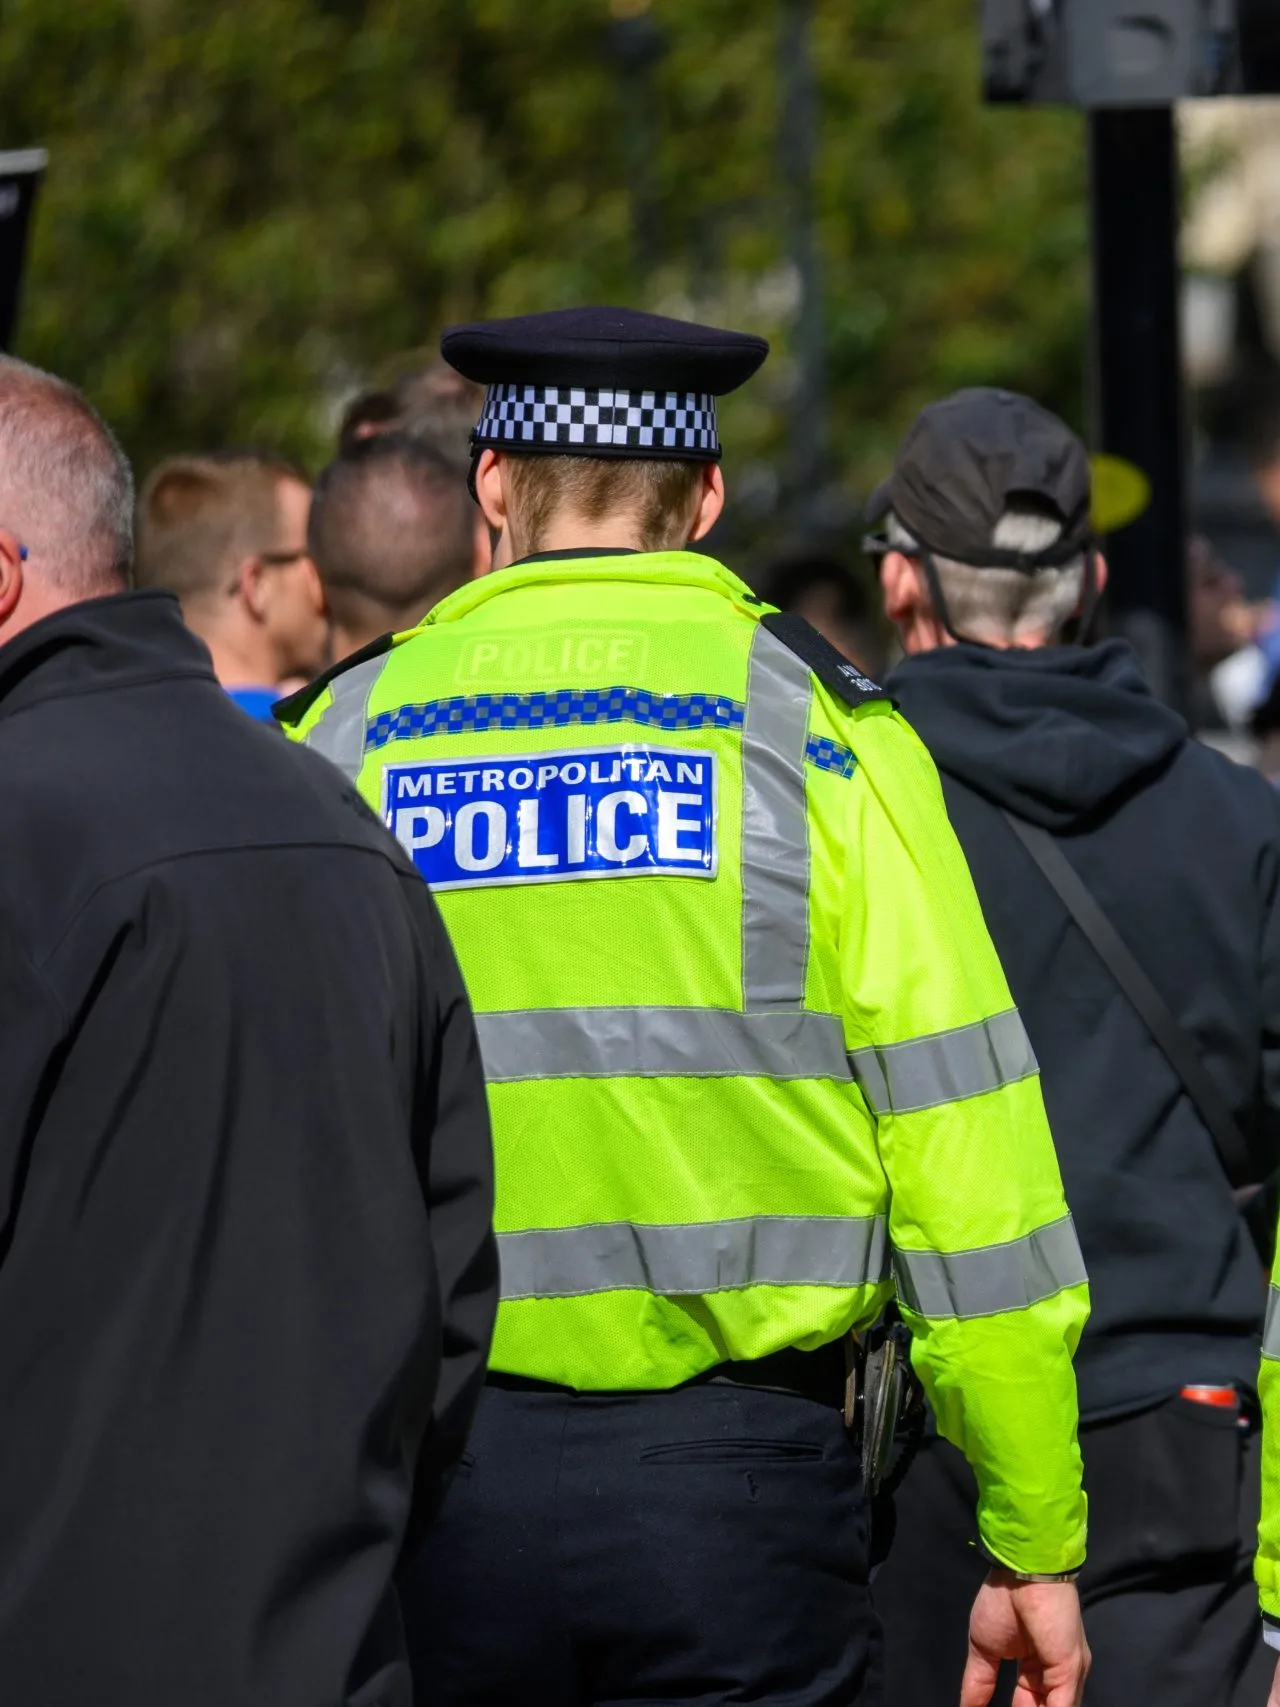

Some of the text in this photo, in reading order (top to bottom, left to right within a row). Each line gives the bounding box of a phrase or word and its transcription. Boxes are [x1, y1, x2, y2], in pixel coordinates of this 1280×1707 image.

[470, 638, 634, 677] POLICE
[398, 759, 703, 798] METROPOLITAN
[395, 790, 703, 872] POLICE
